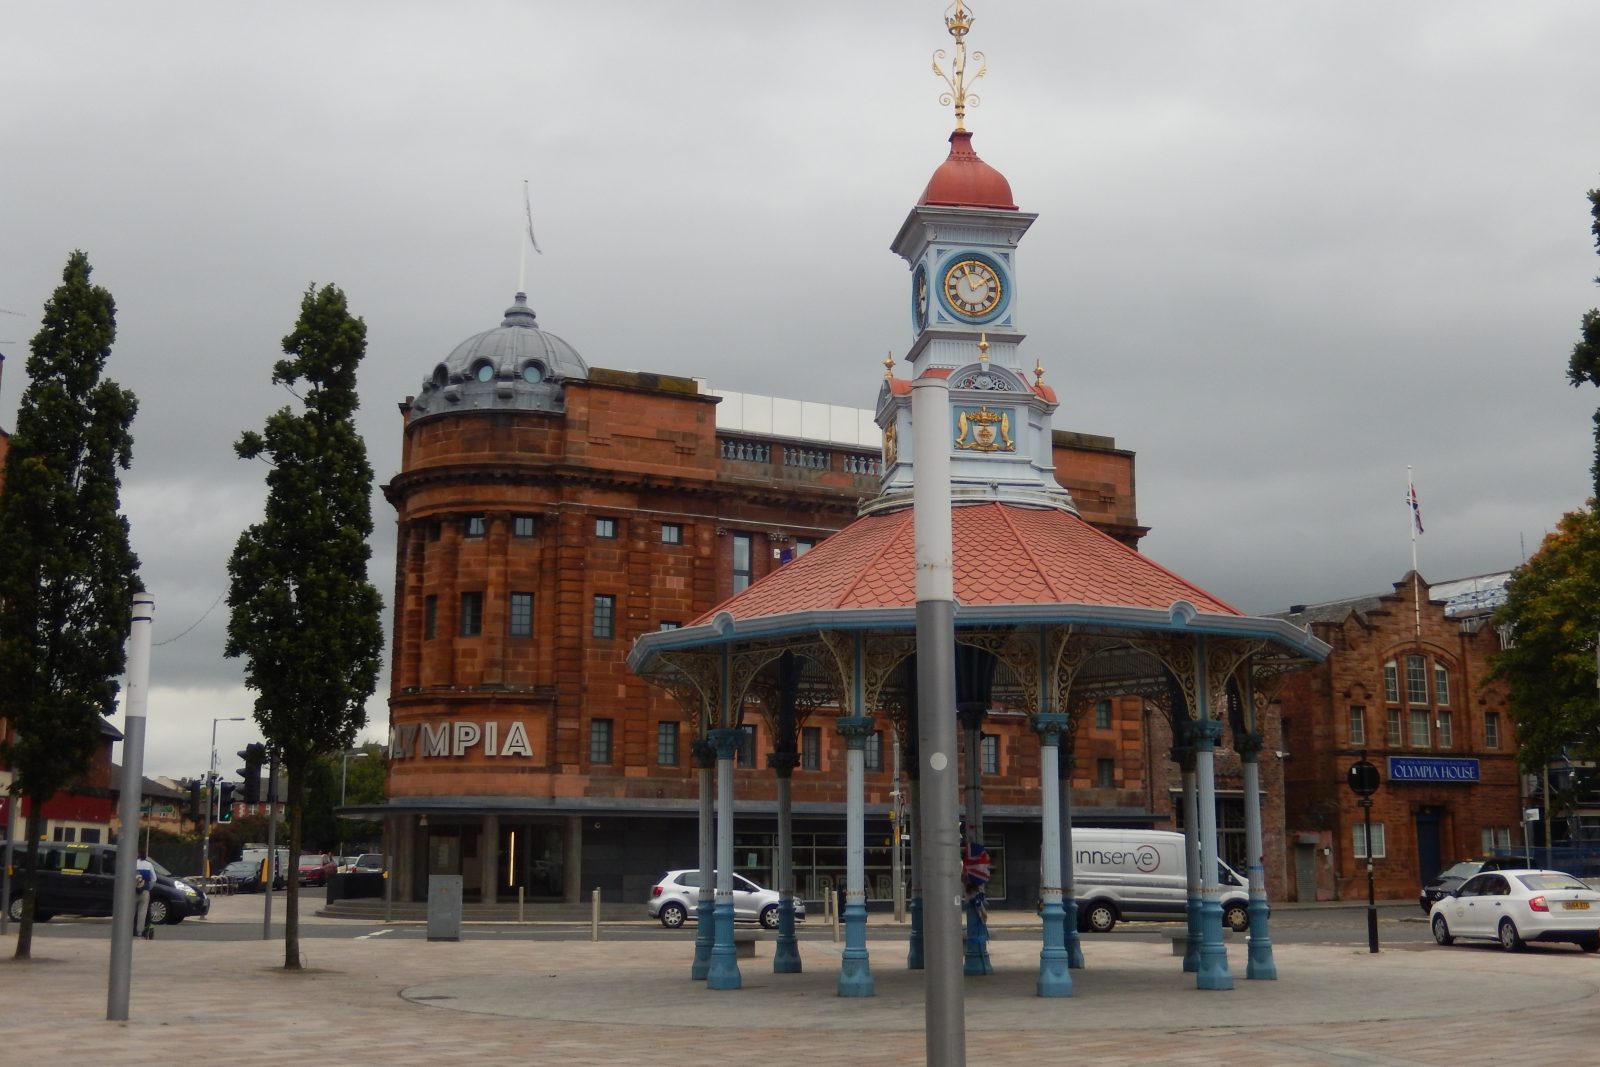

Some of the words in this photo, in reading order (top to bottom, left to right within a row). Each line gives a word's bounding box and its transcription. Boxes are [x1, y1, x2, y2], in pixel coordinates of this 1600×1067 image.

[1394, 764, 1440, 778] OLYMPIA
[1441, 766, 1476, 779] HOUSE
[1076, 850, 1153, 865] innserve
